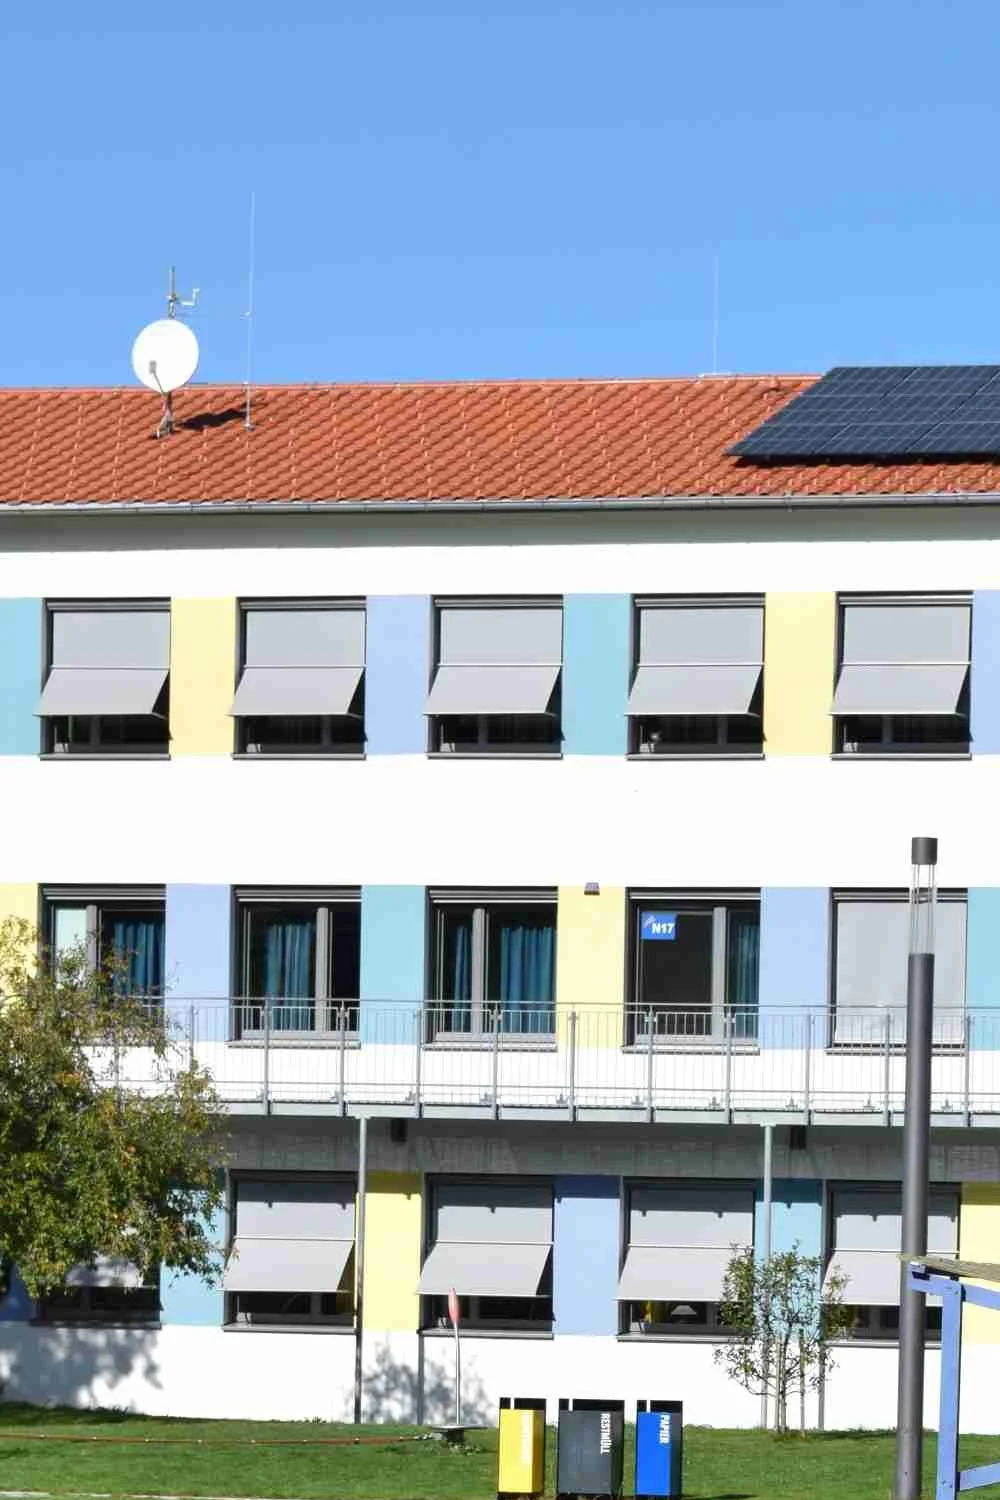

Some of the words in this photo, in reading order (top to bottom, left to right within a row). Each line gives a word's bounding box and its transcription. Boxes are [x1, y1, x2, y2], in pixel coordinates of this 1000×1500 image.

[651, 922, 675, 934] N17
[600, 1413, 612, 1454] RESTMÜLL
[659, 1414, 670, 1444] PAPIER
